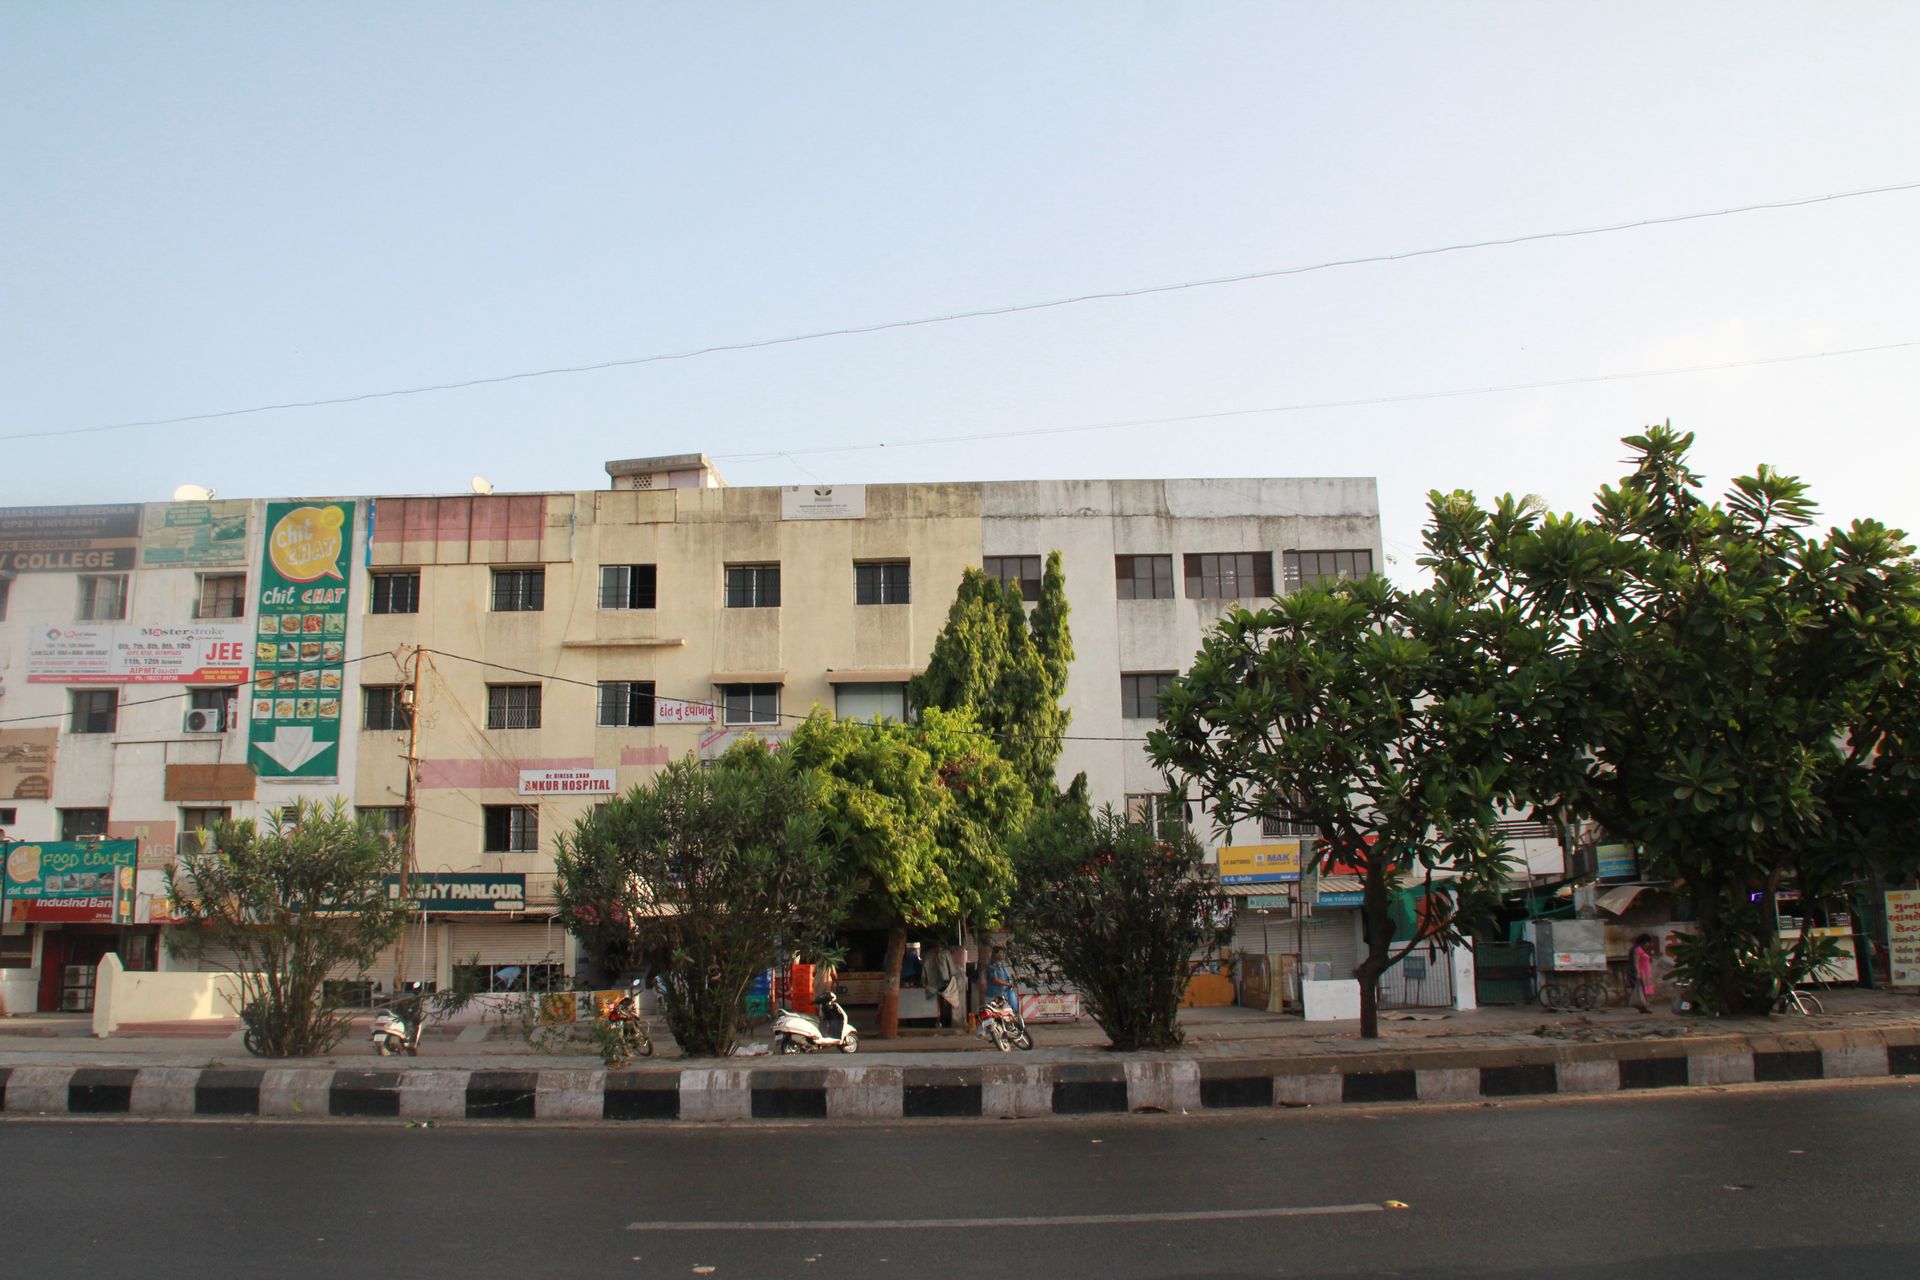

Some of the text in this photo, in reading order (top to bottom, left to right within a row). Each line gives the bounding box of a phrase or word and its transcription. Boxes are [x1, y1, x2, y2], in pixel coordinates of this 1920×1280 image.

[2, 518, 107, 528] OPEN UNIVERSITY
[14, 551, 115, 569] COLLEGE
[302, 588, 346, 604] CHAT
[141, 627, 224, 636] Masterstroke
[206, 642, 243, 660] JEE
[525, 780, 610, 791] ANKUR HOSPITAL
[43, 853, 79, 867] FOOD
[84, 852, 133, 867] COURT
[451, 883, 523, 899] PARLOUR
[36, 897, 112, 908] IndusInd Ban
